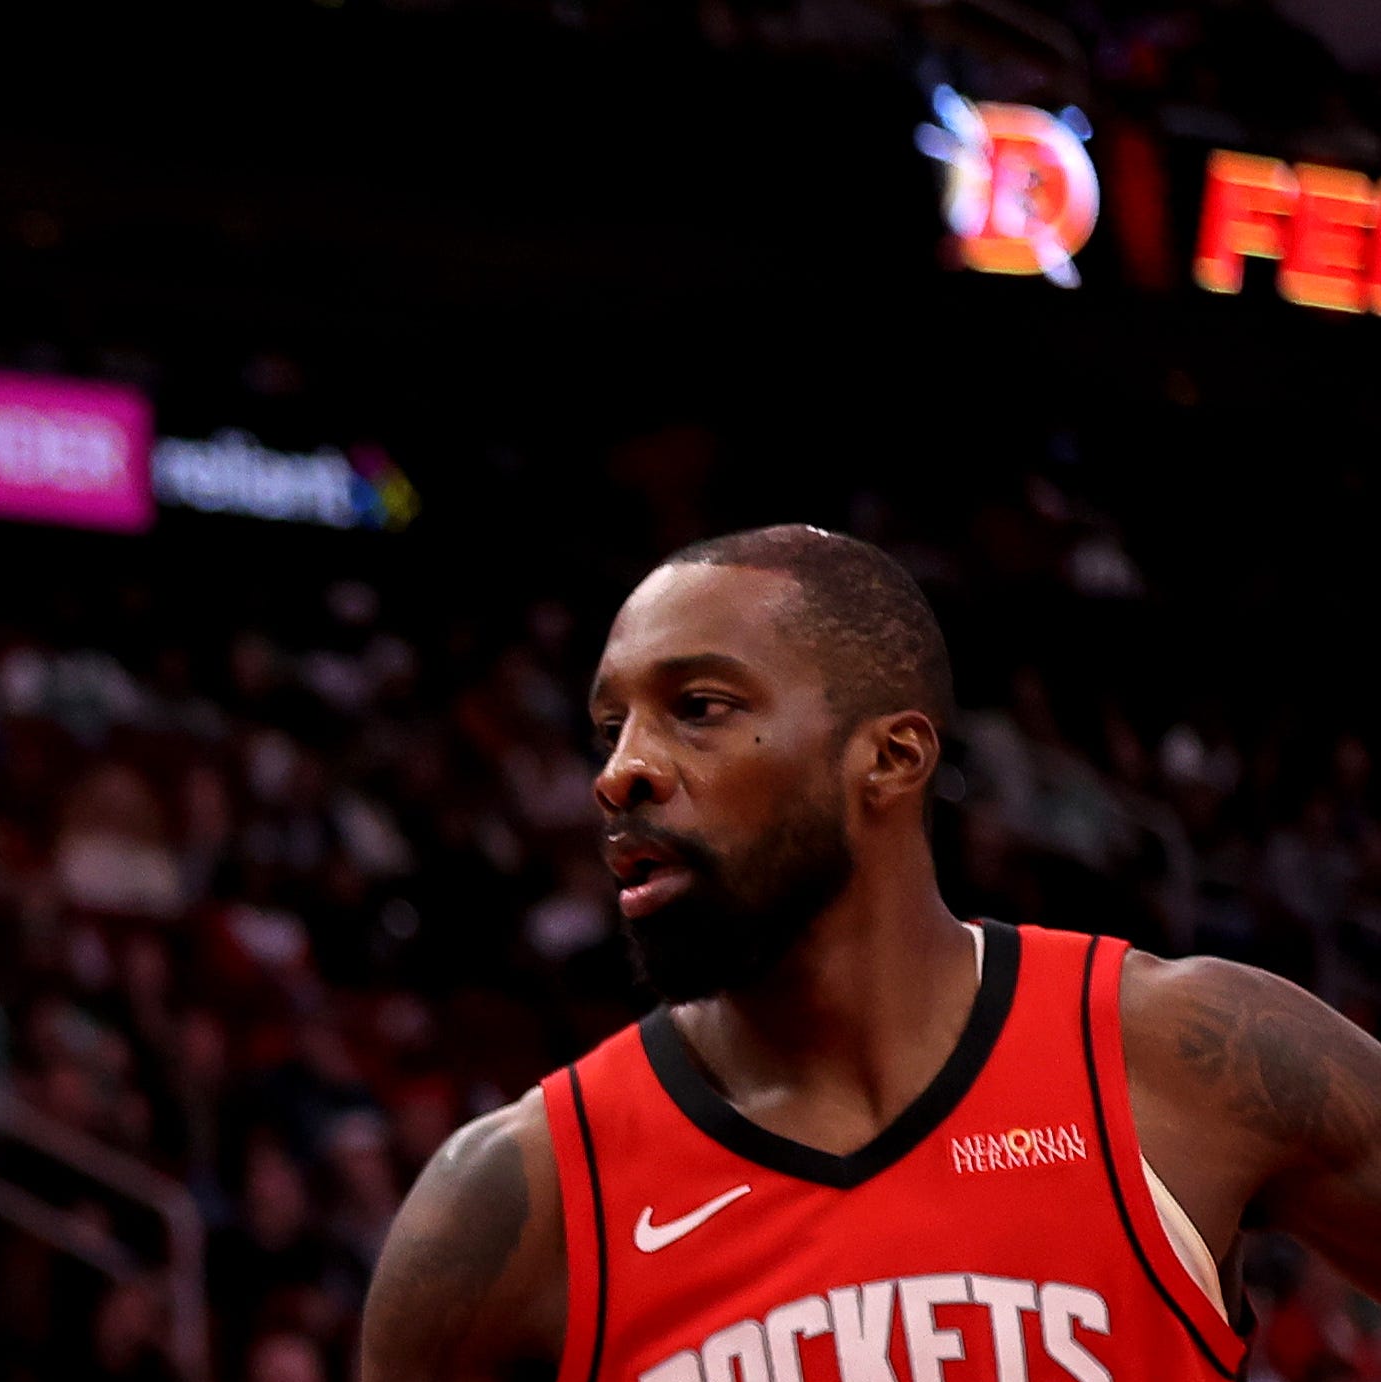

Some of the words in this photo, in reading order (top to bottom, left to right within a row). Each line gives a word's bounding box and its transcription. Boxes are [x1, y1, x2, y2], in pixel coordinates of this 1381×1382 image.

[1192, 149, 1381, 315] FE
[951, 1123, 1086, 1158] MEMORIAL
[953, 1138, 1087, 1174] HERMANN
